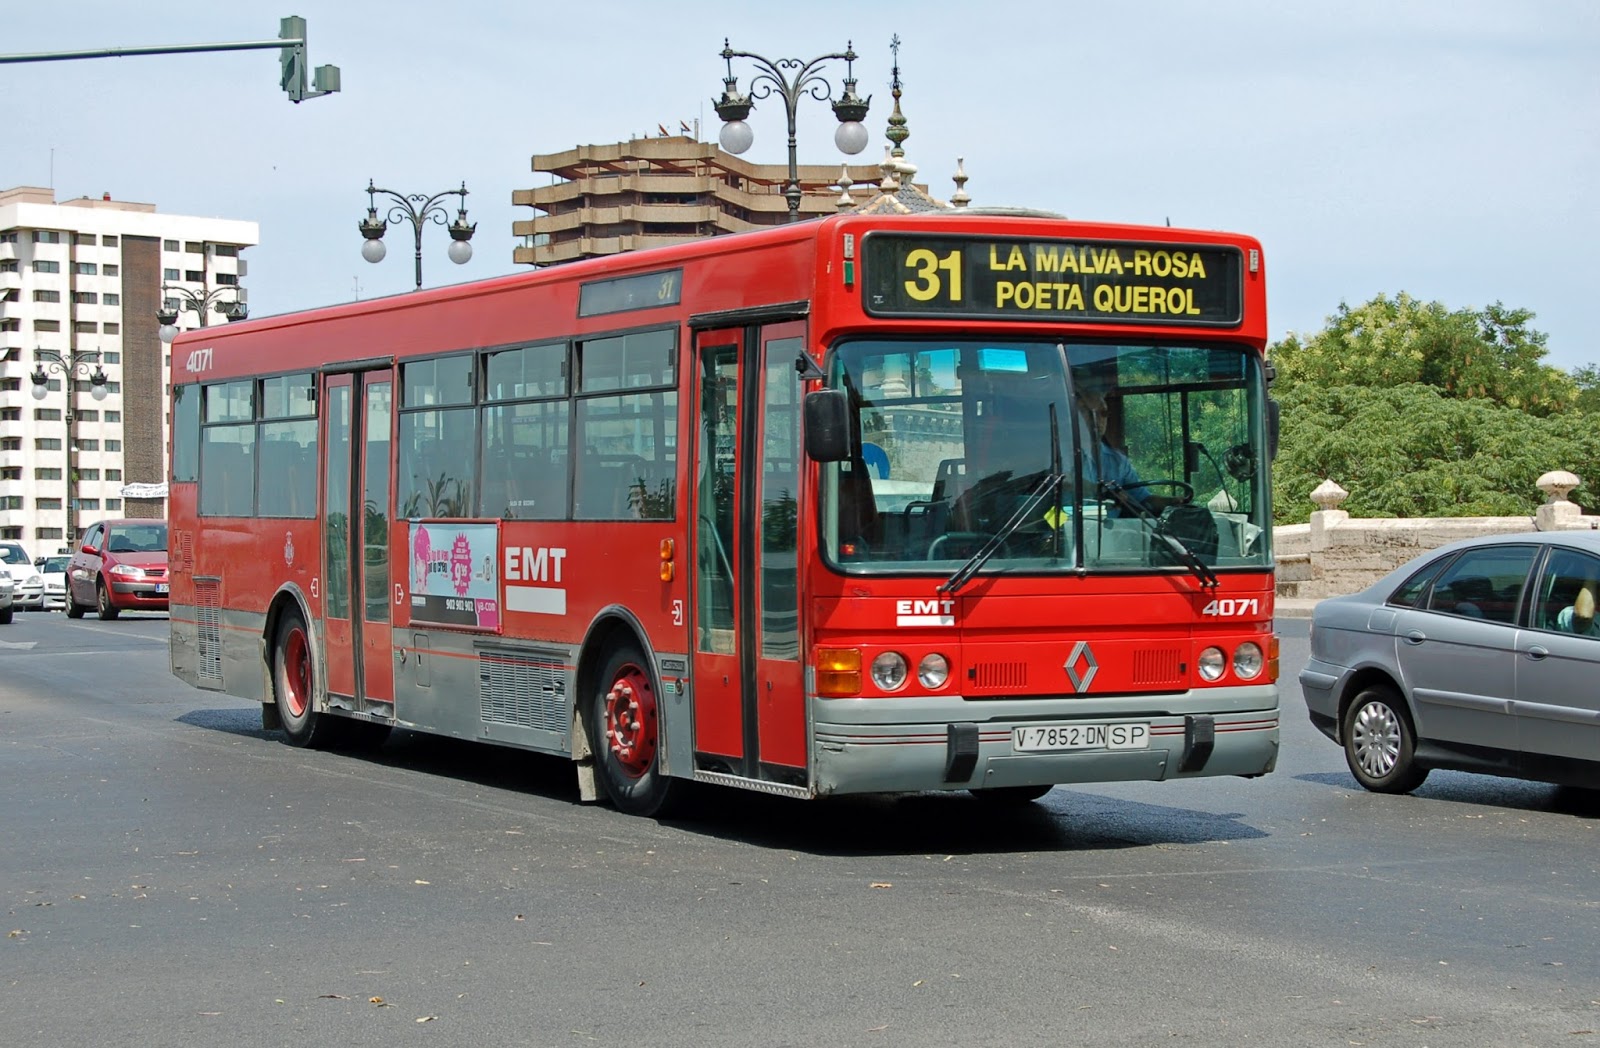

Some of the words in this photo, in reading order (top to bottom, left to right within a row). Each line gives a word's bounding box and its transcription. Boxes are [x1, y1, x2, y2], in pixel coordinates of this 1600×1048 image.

[904, 248, 962, 301] 31
[989, 244, 1026, 272] LA
[1035, 245, 1206, 279] MALVA-ROSA
[996, 282, 1085, 311] POETA
[1093, 284, 1201, 315] QUEROL
[186, 347, 213, 373] 4071
[505, 546, 567, 582] EMT
[446, 599, 455, 610] 902
[456, 600, 464, 611] 902
[465, 601, 474, 612] 902
[896, 600, 955, 614] EMT
[1202, 598, 1259, 616] 4071
